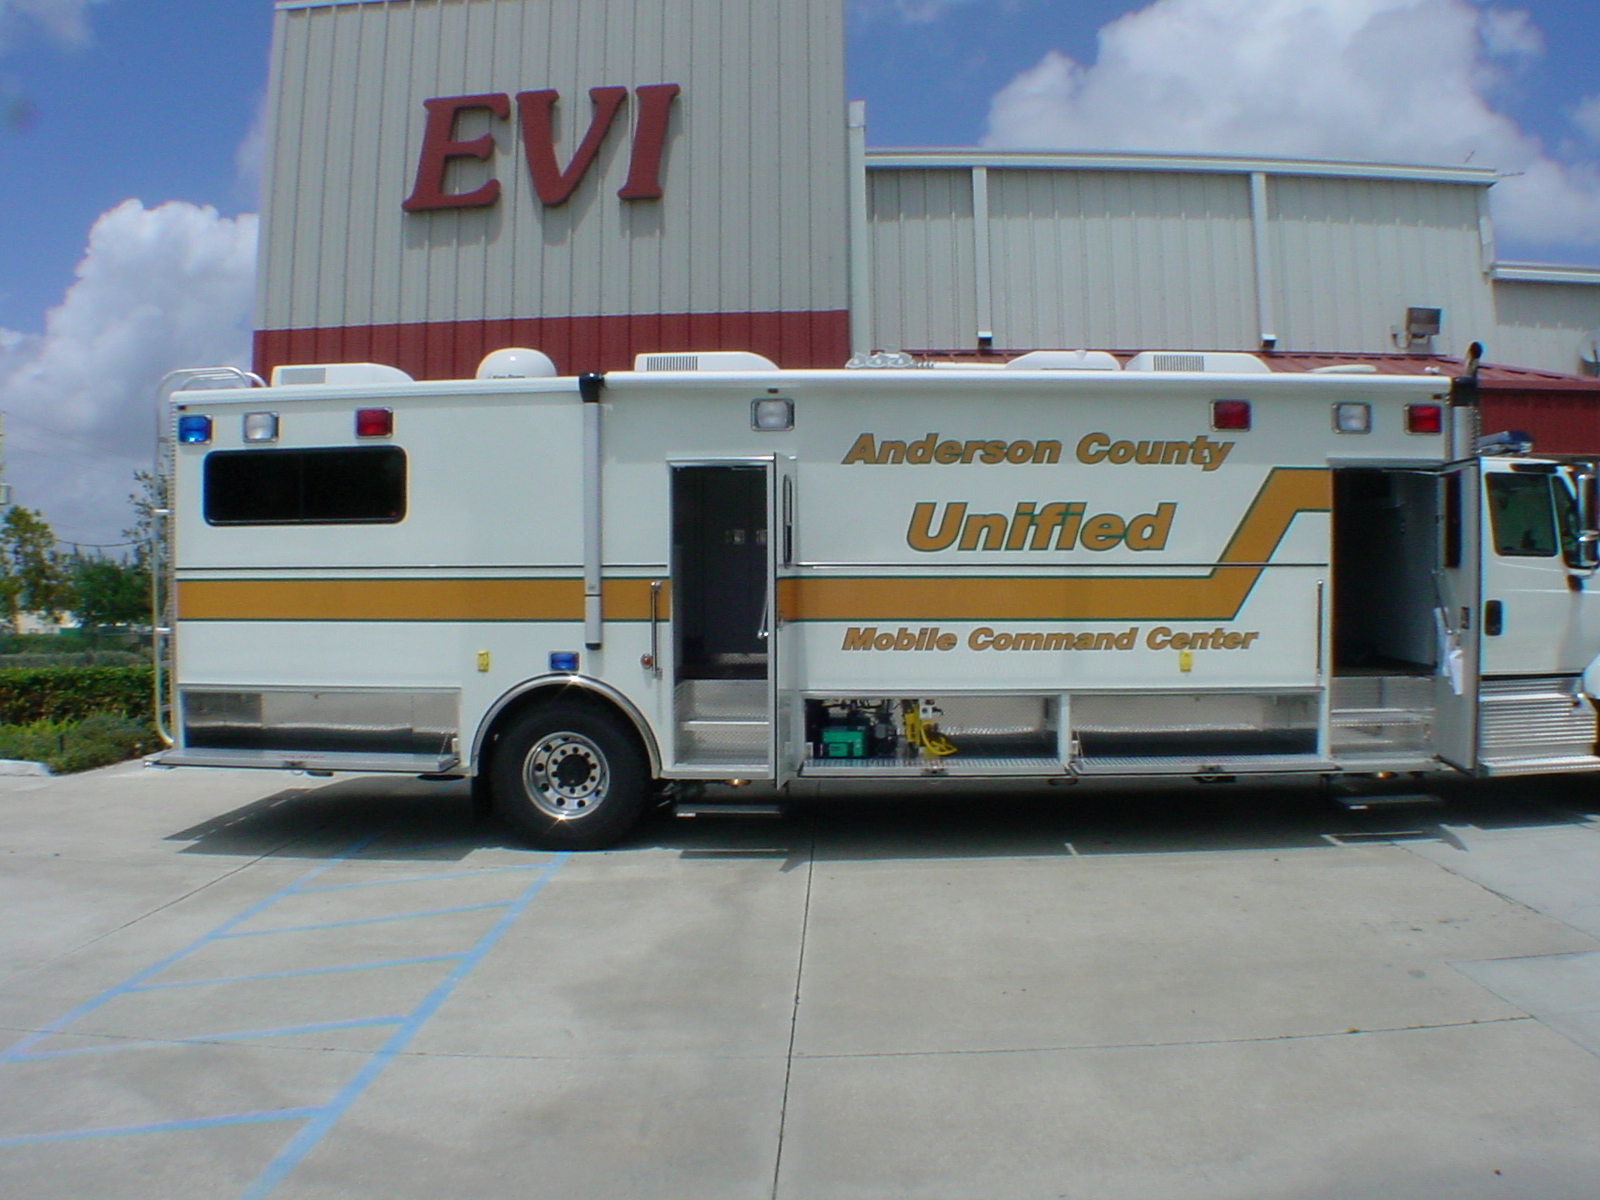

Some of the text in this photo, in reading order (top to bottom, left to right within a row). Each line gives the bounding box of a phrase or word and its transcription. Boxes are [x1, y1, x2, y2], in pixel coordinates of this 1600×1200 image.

[401, 83, 681, 212] EVI
[842, 432, 1235, 471] Anderson County
[907, 502, 1177, 551] Unified
[842, 627, 1259, 651] Mobile Command Center
